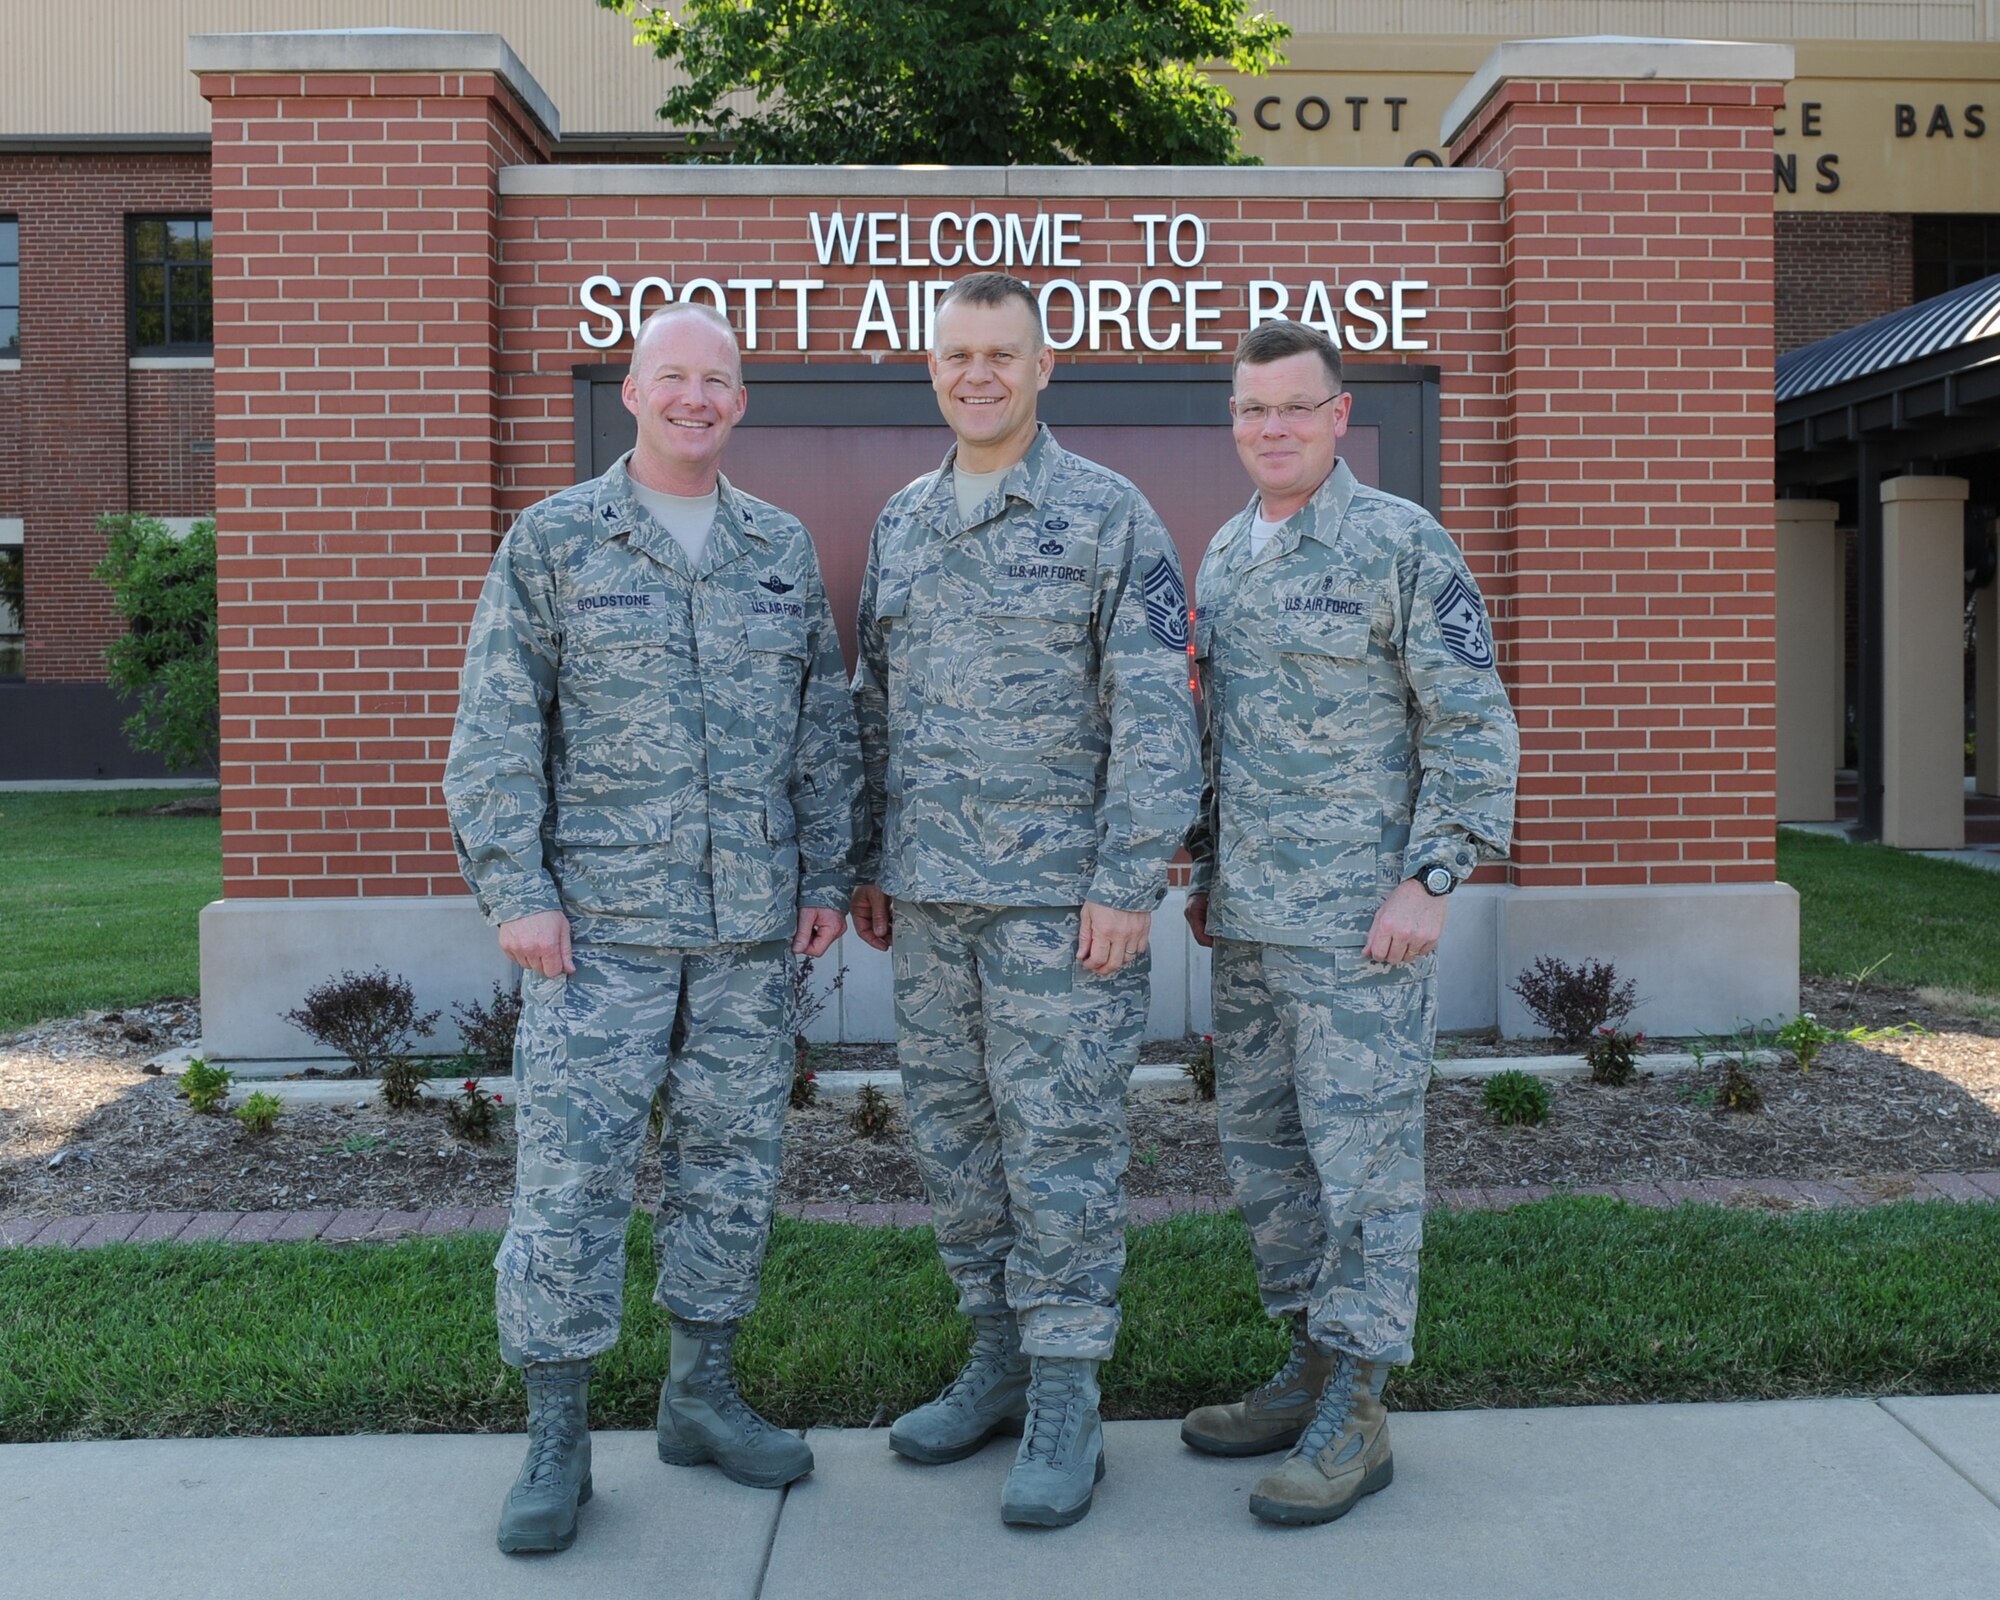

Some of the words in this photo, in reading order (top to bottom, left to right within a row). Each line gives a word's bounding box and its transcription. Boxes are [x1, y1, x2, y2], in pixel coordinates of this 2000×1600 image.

[809, 211, 1083, 267] WELCOME
[1132, 212, 1206, 268] TO
[1026, 278, 1223, 351] ORCE
[1029, 565, 1049, 578] AIR
[1051, 566, 1087, 582] FORCE
[577, 594, 651, 611] GOLDSTONE
[769, 601, 784, 615] AIR
[1304, 598, 1323, 611] AIR
[1325, 599, 1363, 616] FORCE
